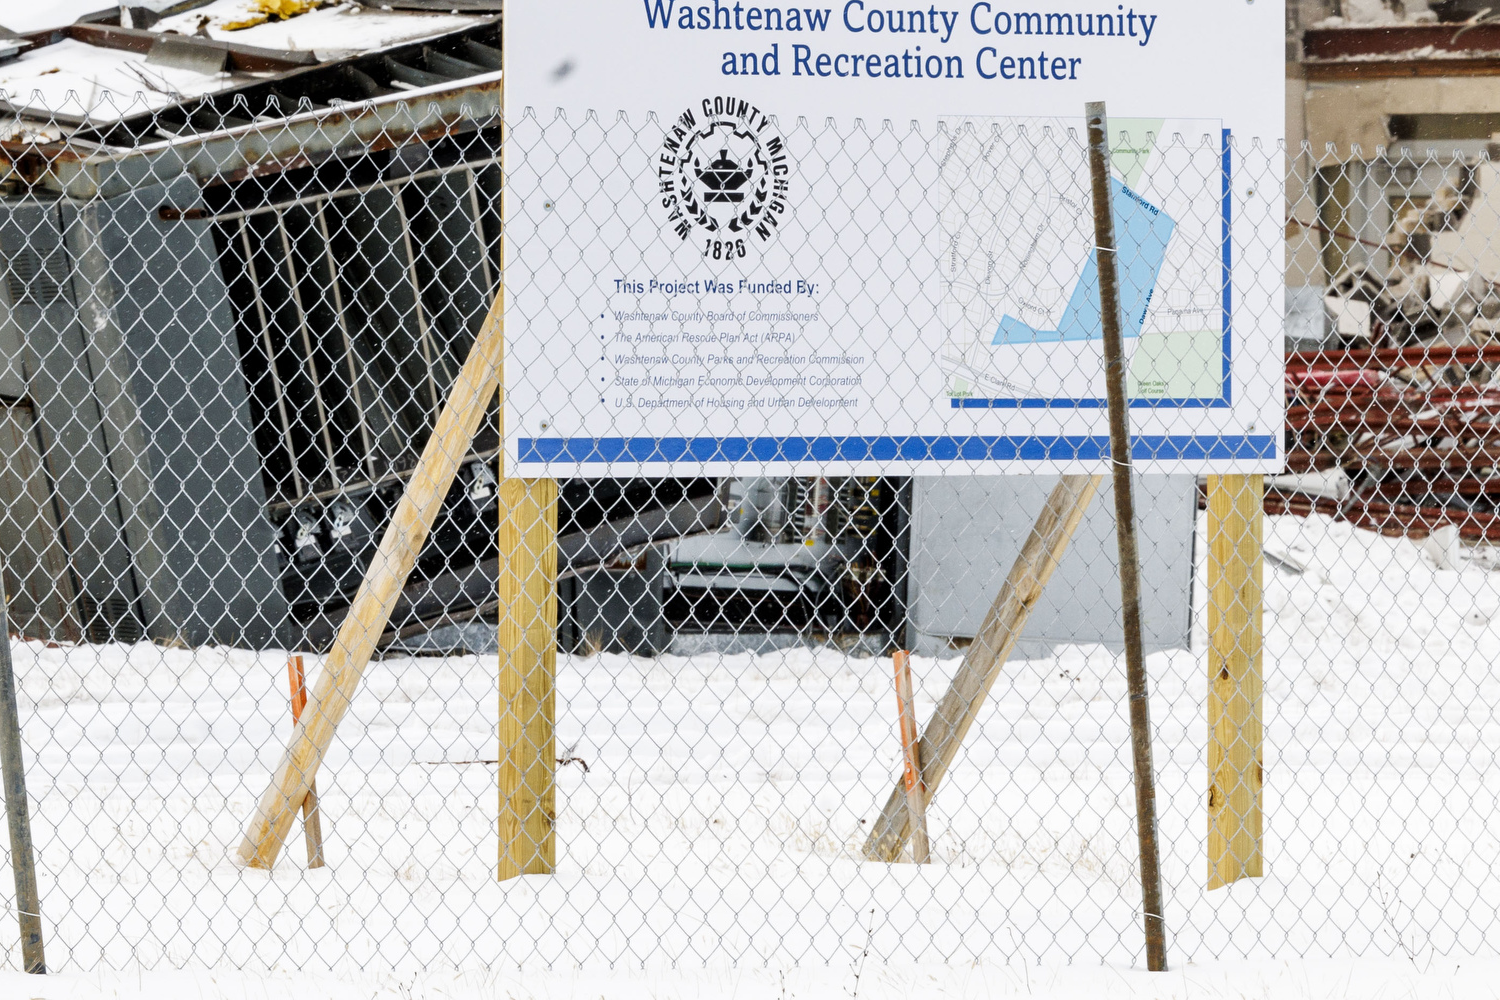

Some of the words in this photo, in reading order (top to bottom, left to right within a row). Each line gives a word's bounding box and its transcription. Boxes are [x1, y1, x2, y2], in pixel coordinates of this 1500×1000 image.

[842, 0, 959, 44] County
[970, 1, 1158, 47] Community
[721, 43, 781, 76] and
[791, 43, 965, 78] Recreation
[975, 46, 1082, 81] Center
[658, 108, 697, 241] WASHTENAW
[702, 96, 771, 133] COUNTY
[755, 136, 789, 242] MICHIGAN
[1121, 185, 1149, 210] Stamford
[1148, 204, 1160, 217] Rd
[704, 238, 747, 261] 1826
[950, 240, 959, 273] Stratford
[613, 279, 644, 294] This
[649, 279, 700, 298] Project
[704, 279, 734, 294] Was
[738, 279, 792, 294] Funded
[796, 279, 819, 298] By:
[1145, 288, 1154, 303] Ave
[614, 310, 669, 321] Washtenaw
[671, 310, 704, 324] County
[706, 310, 735, 321] Board
[735, 310, 747, 321] of
[748, 310, 819, 322] Commissioners
[614, 332, 633, 343] The
[635, 332, 679, 343] American
[682, 332, 717, 343] Rescue
[719, 332, 741, 343] Plan
[742, 332, 758, 343] Act
[760, 332, 796, 345] (ARPA)
[614, 354, 669, 365] Washtenaw
[671, 354, 705, 367] County
[707, 354, 734, 365] Parks
[736, 354, 754, 365] and
[756, 354, 806, 365] Recreation
[808, 354, 865, 365] Commission
[614, 375, 639, 387] State
[641, 375, 652, 387] of
[653, 375, 695, 389] Michigan
[697, 375, 743, 387] Economic
[746, 375, 807, 388] Development
[809, 375, 863, 388] Corporation
[614, 397, 635, 408] U.S.
[637, 397, 692, 410] Department
[694, 397, 705, 408] of
[706, 397, 745, 410] Housing
[747, 397, 765, 408] and
[767, 397, 795, 408] Urban
[797, 397, 858, 410] Development
